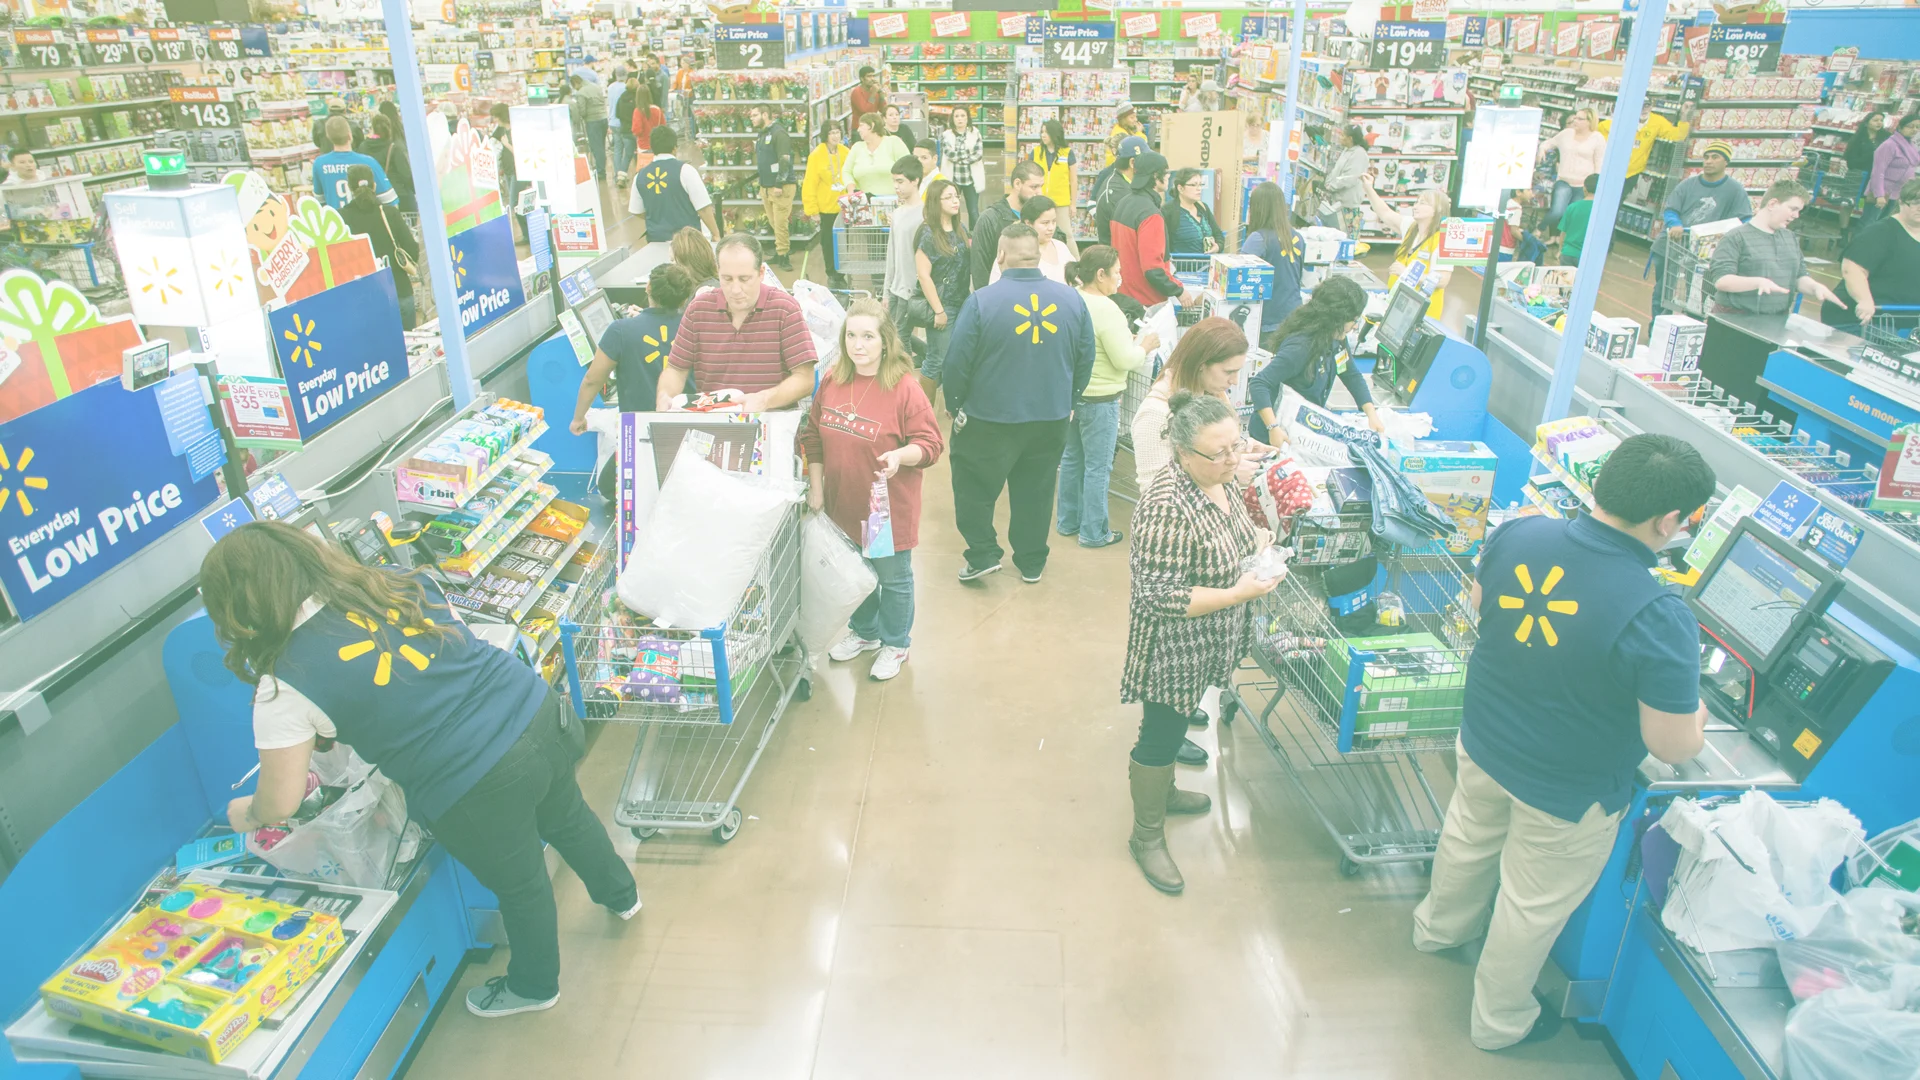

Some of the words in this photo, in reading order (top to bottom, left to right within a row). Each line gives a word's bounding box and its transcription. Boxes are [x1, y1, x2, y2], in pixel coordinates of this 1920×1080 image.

[26, 34, 52, 42] Rollback
[729, 31, 747, 39] Low
[747, 30, 768, 39] Price
[1059, 29, 1077, 37] Low
[1077, 28, 1099, 37] Price
[1390, 27, 1408, 37] Low
[1408, 28, 1430, 37] Price
[1465, 36, 1481, 44] Low
[1725, 32, 1744, 40] Low
[1744, 31, 1767, 40] Price
[31, 45, 61, 66] $79
[219, 41, 239, 58] $89
[245, 47, 264, 56] Price
[740, 43, 764, 67] $2
[183, 90, 215, 99] Rollback
[180, 103, 231, 127] $143
[114, 202, 137, 216] Self
[118, 216, 176, 231] Checkout
[560, 225, 576, 234] $35
[1448, 230, 1465, 240] $35
[266, 235, 299, 281] MERRY
[273, 248, 304, 289] CHRISTMAS
[461, 303, 480, 327] ow
[479, 288, 510, 317] Price
[1683, 355, 1698, 371] 23
[297, 367, 337, 395] Everyday
[231, 384, 257, 395] SAVE
[257, 390, 280, 399] EVER
[301, 383, 344, 424] Low
[344, 360, 390, 400] Price
[234, 395, 260, 410] $35
[1847, 395, 1871, 414] Save
[1297, 435, 1348, 461] SUPERIOR
[413, 480, 456, 501] Orbit
[261, 504, 278, 520] $3
[1759, 507, 1772, 517] debit
[1770, 513, 1783, 526] cards
[1765, 500, 1777, 512] Cash,
[1775, 508, 1791, 520] credit,
[8, 507, 81, 555] Everyday
[17, 527, 100, 594] Low
[97, 482, 183, 546] Price
[1808, 527, 1825, 546] $3
[1816, 516, 1836, 532] CASH
[1834, 526, 1858, 546] QUICK
[445, 593, 482, 611] SNICKERS
[62, 977, 77, 986] FUN
[76, 980, 101, 992] FACTORY
